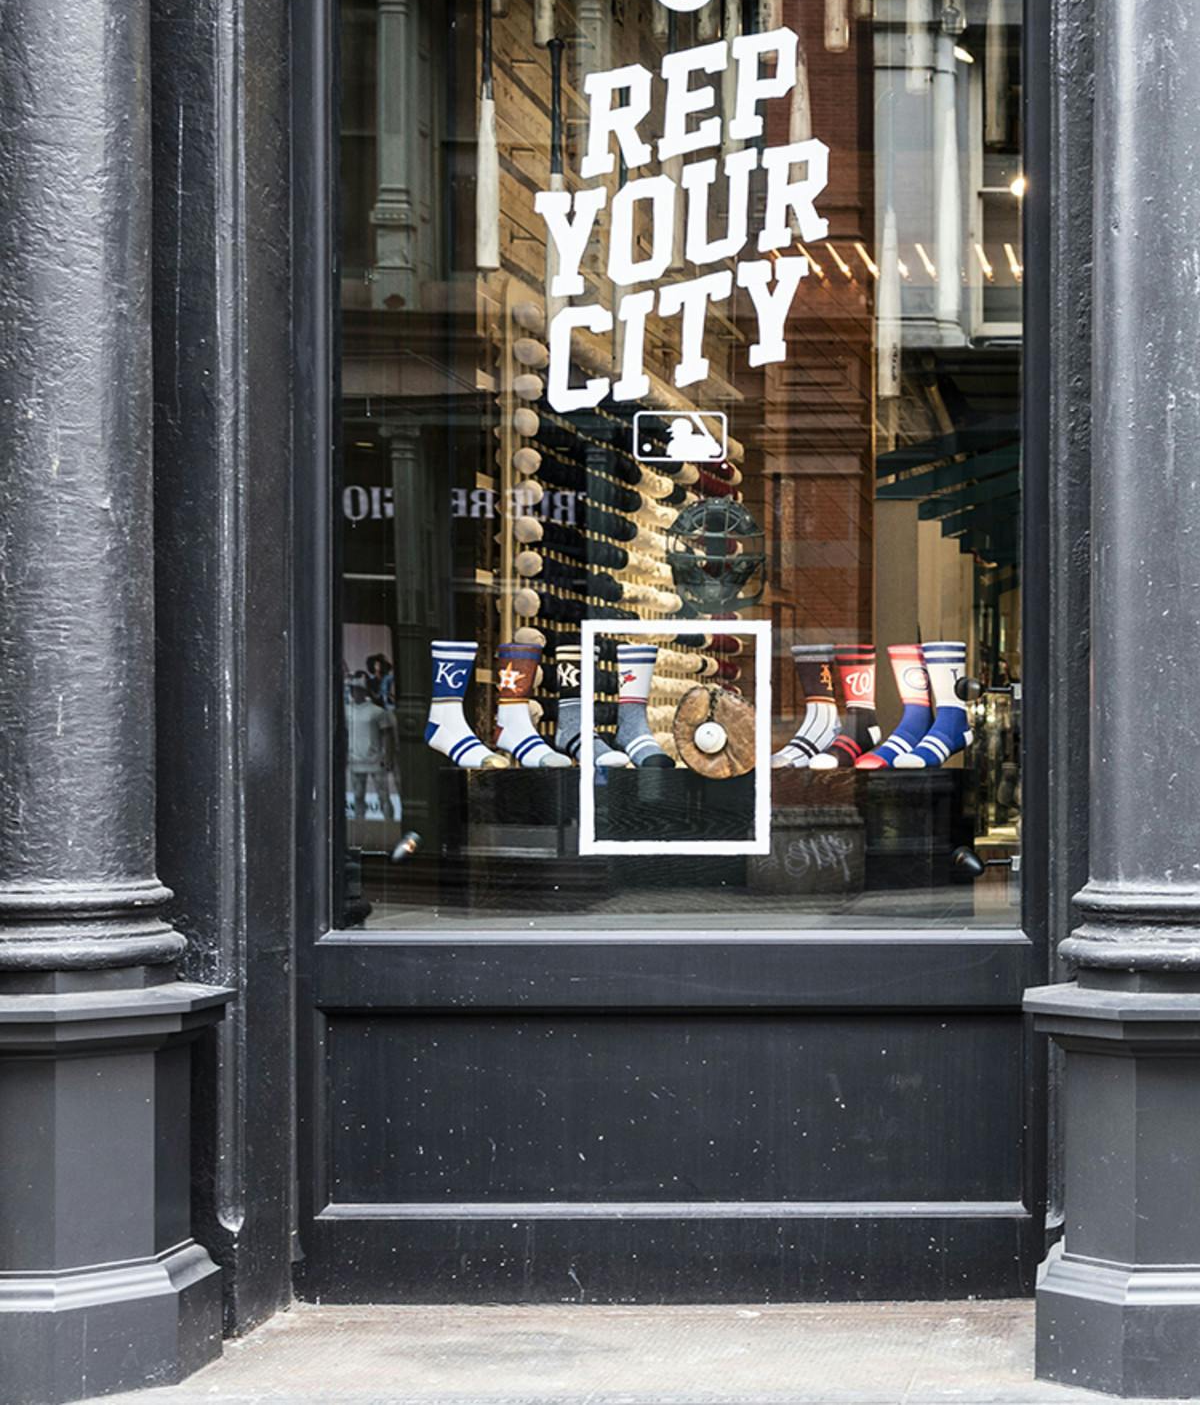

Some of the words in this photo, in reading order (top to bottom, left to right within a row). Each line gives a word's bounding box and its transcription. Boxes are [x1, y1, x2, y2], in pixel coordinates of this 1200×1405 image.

[580, 26, 799, 179] REP
[534, 138, 830, 297] YOUR
[547, 256, 809, 413] CITY
[435, 661, 468, 689] KC
[846, 668, 875, 696] W
